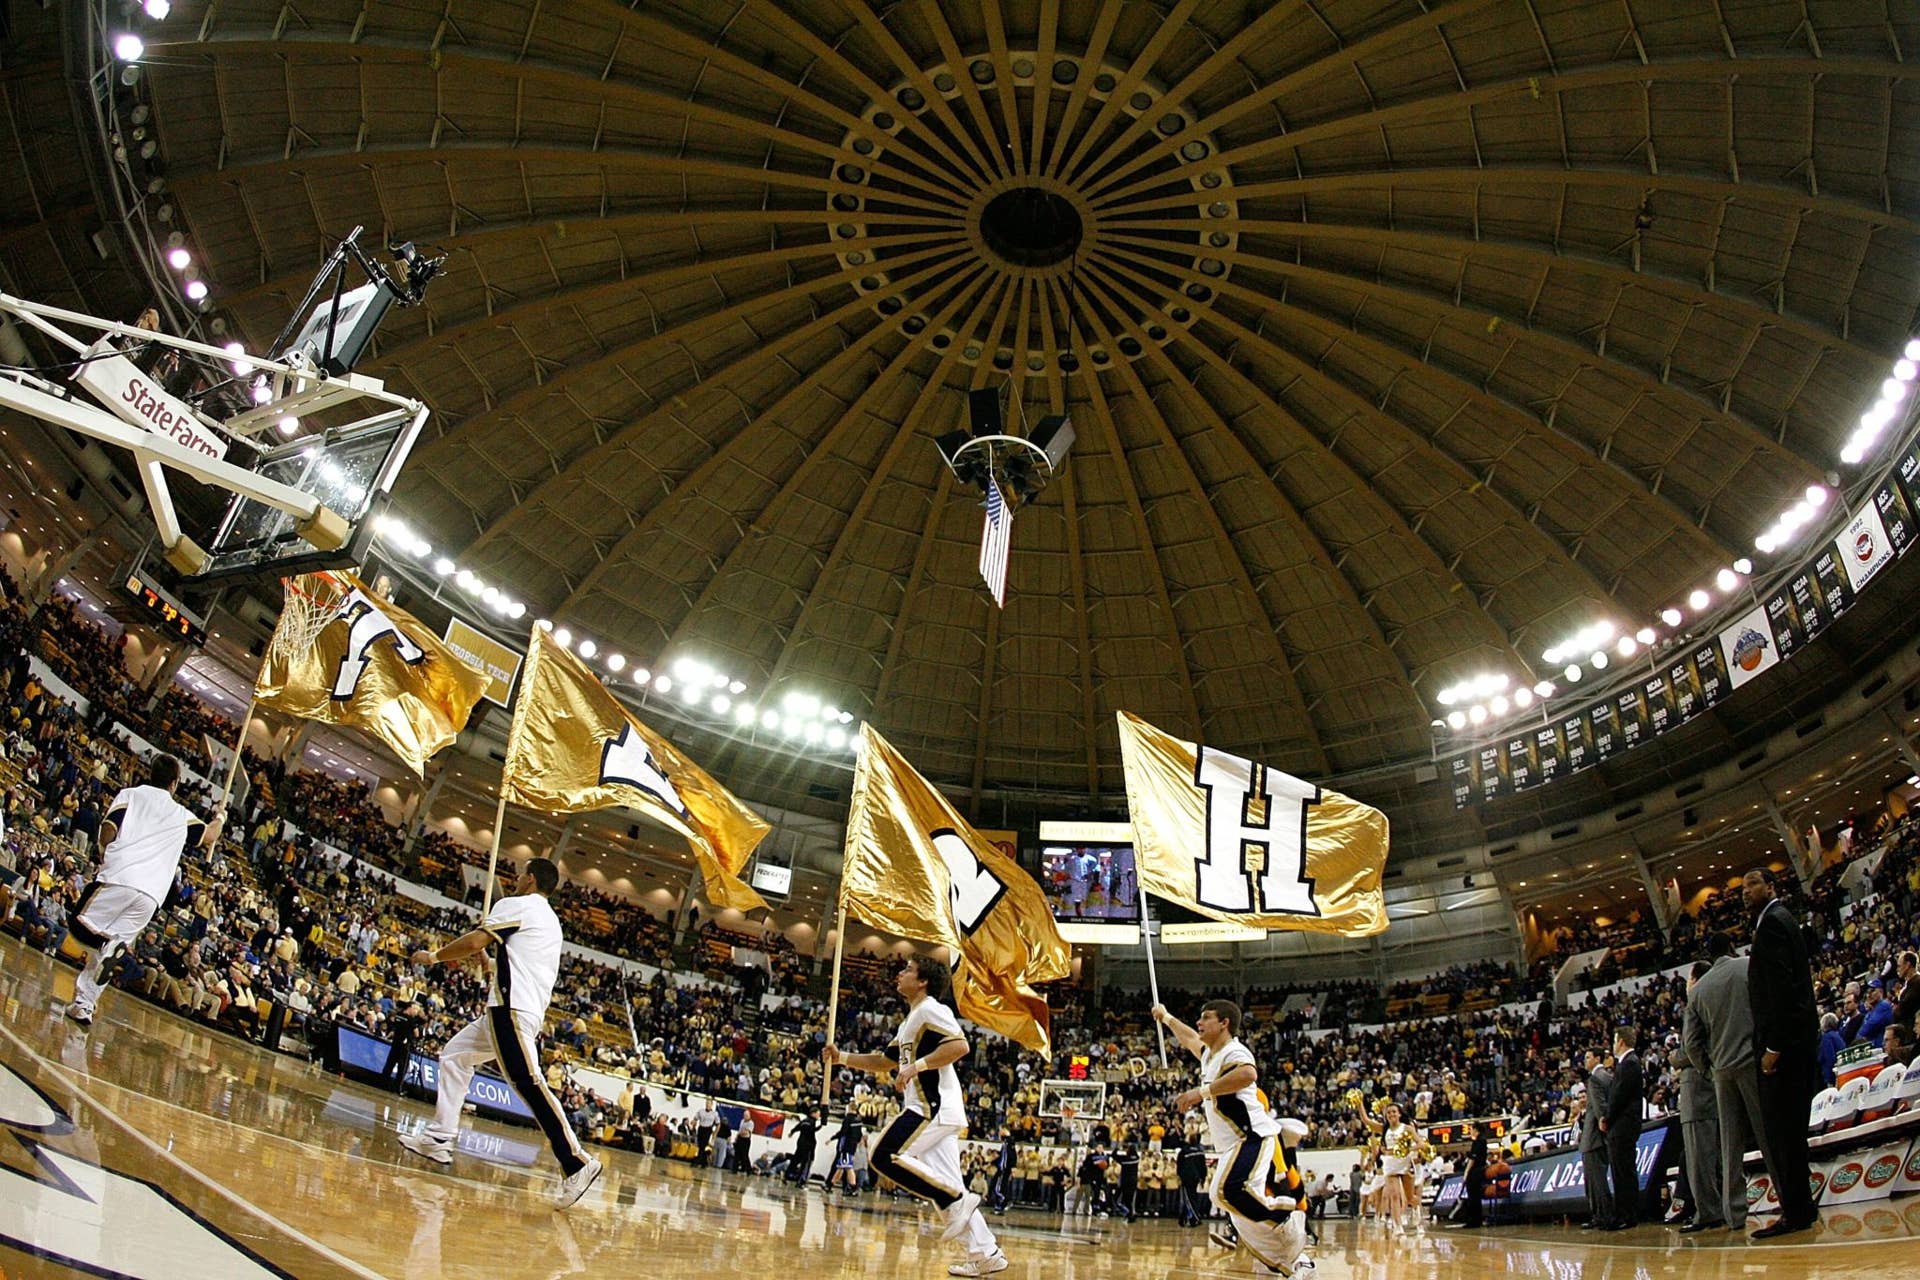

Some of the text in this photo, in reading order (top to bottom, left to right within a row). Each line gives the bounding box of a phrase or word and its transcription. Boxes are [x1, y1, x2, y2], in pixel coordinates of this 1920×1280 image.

[1856, 550, 1891, 588] CHAMPIONS
[1793, 576, 1809, 593] NCAA
[1827, 586, 1842, 603] 1992
[1768, 596, 1784, 614] NCAA
[1803, 608, 1817, 624] 1992
[1697, 648, 1713, 662] NCAA
[1672, 665, 1685, 678] ACC
[1646, 678, 1663, 692] NCAA
[1619, 692, 1636, 706] NCAA
[1592, 705, 1608, 719] NCAA
[1566, 718, 1582, 731] NCAA
[1538, 729, 1555, 741] NCAA
[1510, 740, 1522, 751] ACC
[1481, 748, 1498, 760] NCAA
[1453, 760, 1464, 770] SEC
[1195, 744, 1321, 917] H
